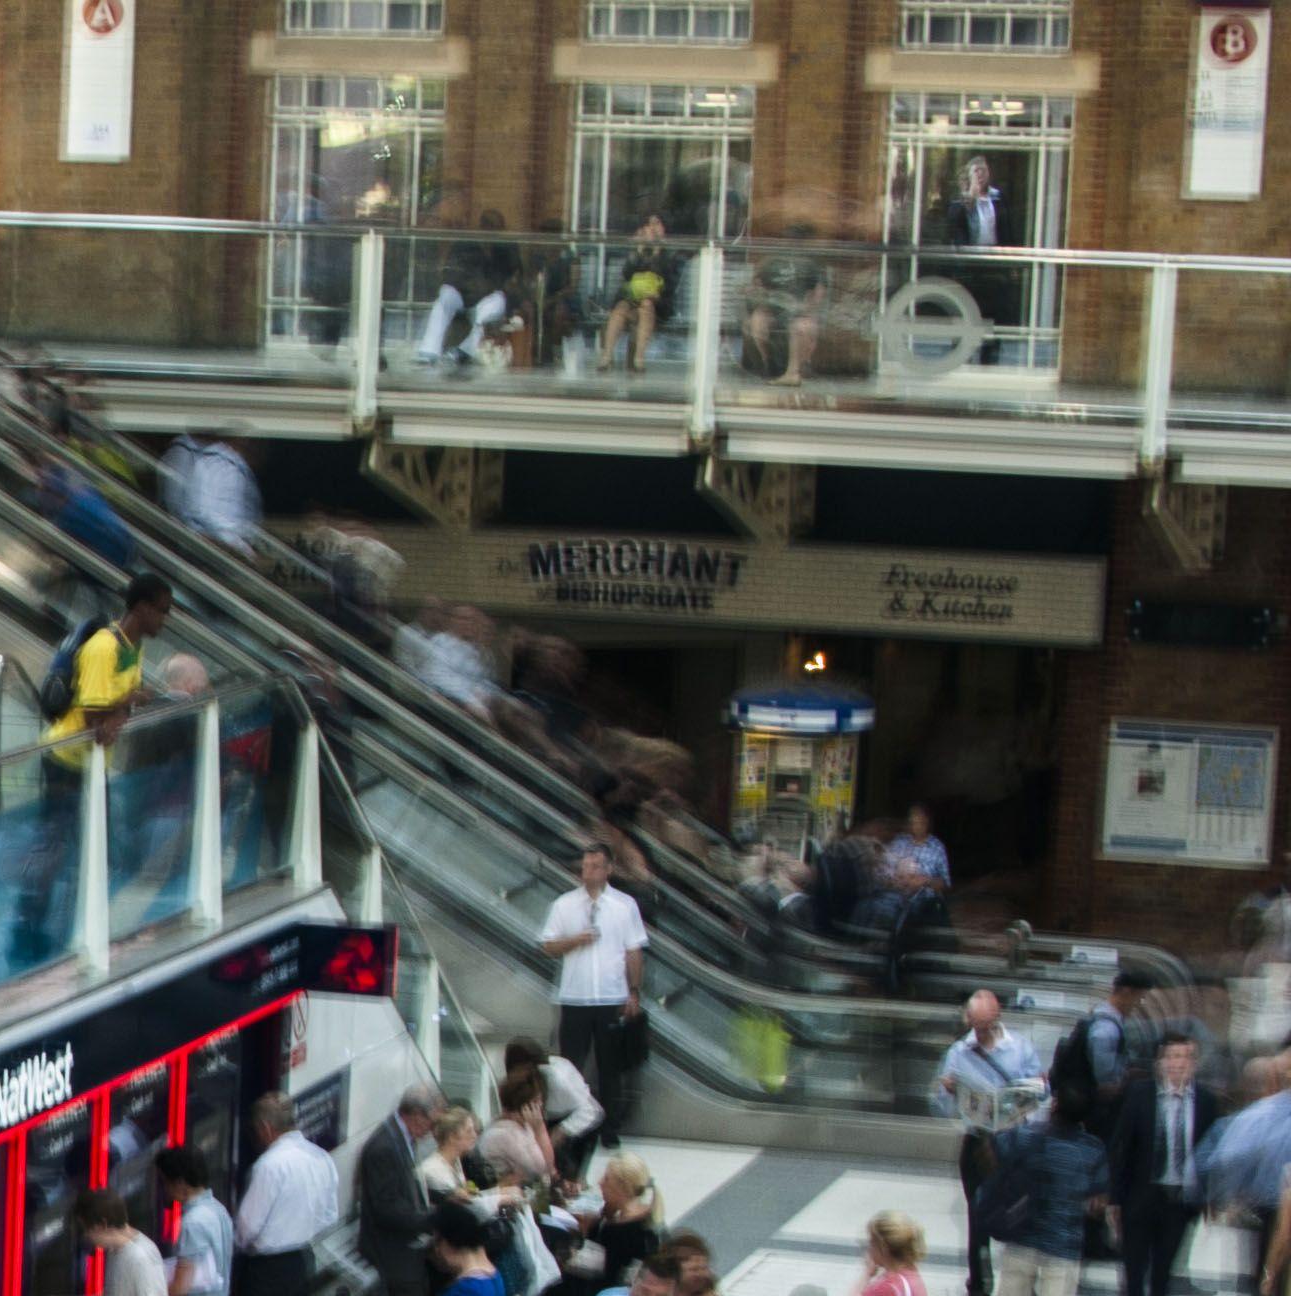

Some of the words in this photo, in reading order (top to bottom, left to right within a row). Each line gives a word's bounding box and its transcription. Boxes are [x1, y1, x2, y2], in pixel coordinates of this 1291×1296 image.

[91, 0, 116, 28] A
[1224, 24, 1247, 54] B
[528, 538, 748, 586] MERCHANT
[555, 582, 716, 610] BISHOPSGATE
